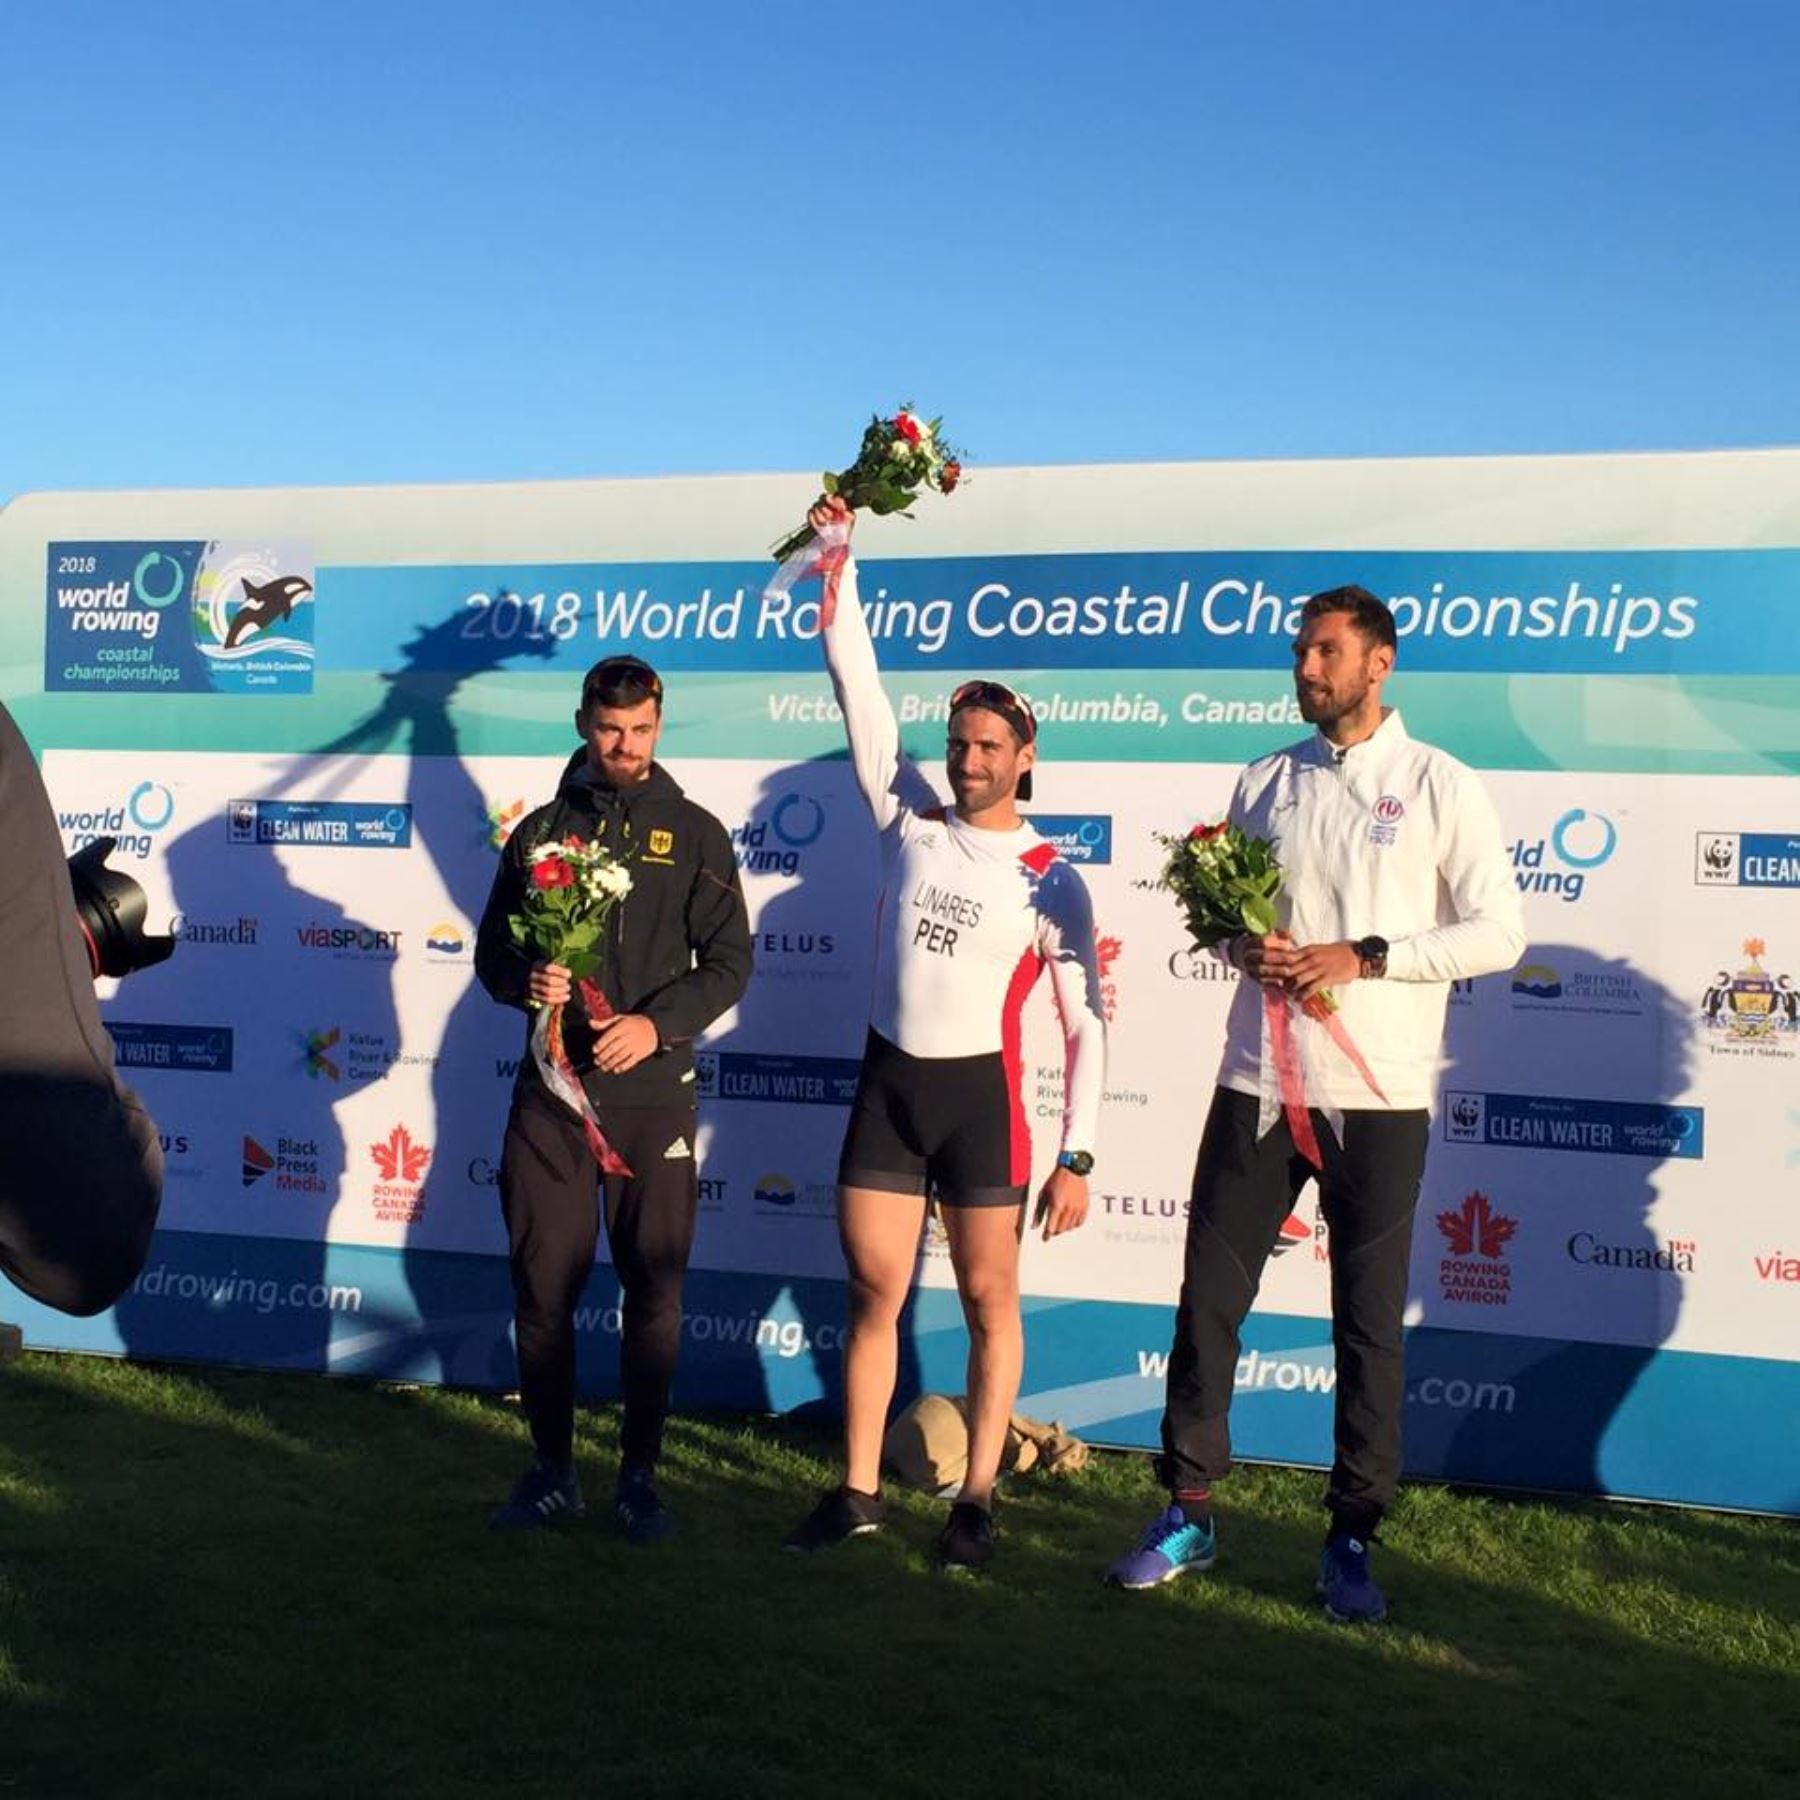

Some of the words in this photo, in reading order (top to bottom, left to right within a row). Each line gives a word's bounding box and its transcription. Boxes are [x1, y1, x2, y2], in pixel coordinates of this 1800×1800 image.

[58, 556, 96, 574] 2018
[57, 581, 130, 608] world
[71, 610, 160, 640] rowing
[460, 591, 581, 640] 2018
[595, 590, 737, 640] World
[756, 588, 954, 653] Roing
[967, 581, 1189, 638] Coastal
[1201, 579, 1698, 653] Chapionships
[97, 646, 154, 662] coastal
[64, 663, 181, 685] championships
[768, 694, 843, 722] Victo
[1022, 693, 1169, 727] olumbia,
[1182, 692, 1304, 725] Canada
[59, 807, 125, 831] world
[261, 819, 300, 841] CLEAN
[303, 820, 348, 842] WATER
[731, 819, 767, 847] rld
[72, 833, 152, 859] roing
[735, 850, 798, 877] wing
[912, 879, 983, 929] LINARES
[169, 913, 256, 945] Canada
[913, 917, 958, 957] PER
[724, 1072, 769, 1097] CLEAN
[772, 1075, 825, 1099] WATER
[1037, 1067, 1065, 1080] Kaf
[1103, 1091, 1149, 1105] owing
[1490, 1116, 1545, 1143] CLEAN
[1551, 1120, 1614, 1147] WATER
[1624, 1122, 1664, 1136] world
[278, 1138, 318, 1155] Black
[276, 1157, 317, 1173] Press
[276, 1175, 326, 1194] Media
[373, 1184, 425, 1199] ROWING
[1567, 1232, 1694, 1274] Canada
[1440, 1260, 1511, 1277] ROWING
[134, 1264, 362, 1313] ldrowing.com
[1440, 1273, 1512, 1291] CANADA
[1443, 1287, 1507, 1305] AVIRON
